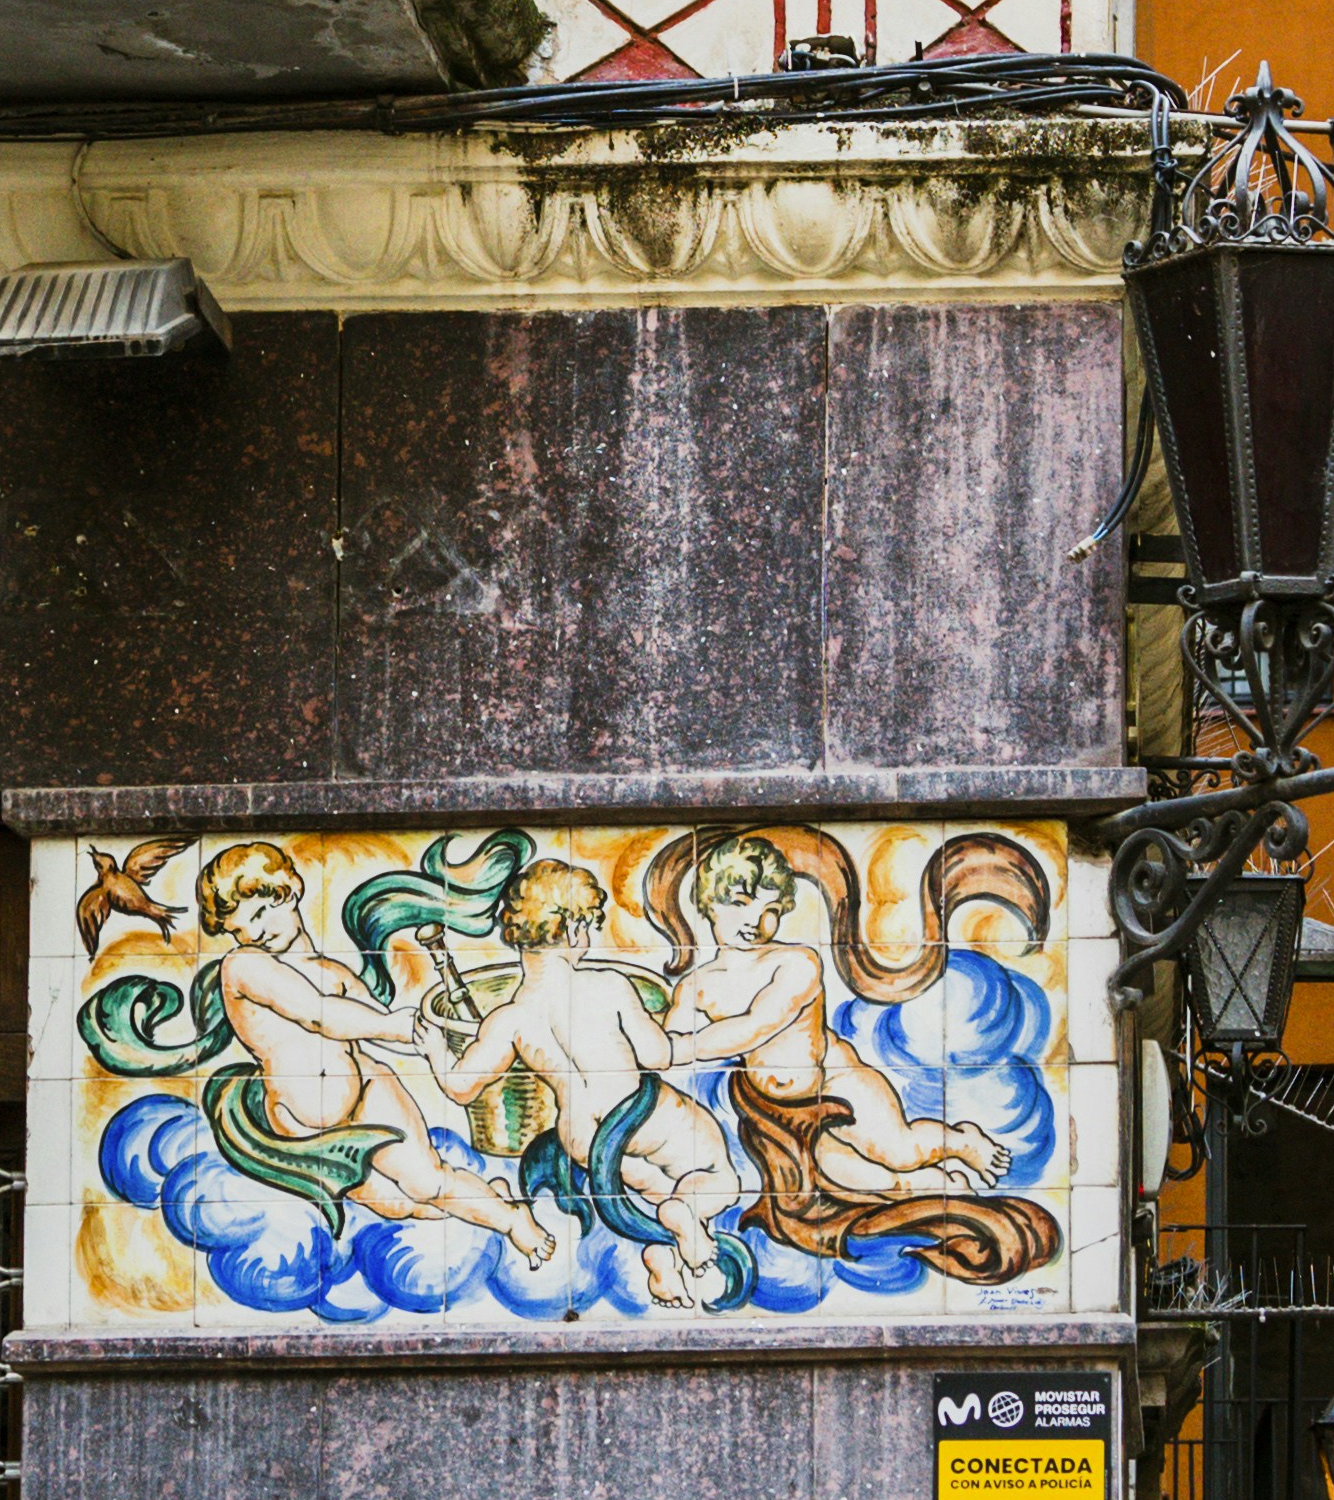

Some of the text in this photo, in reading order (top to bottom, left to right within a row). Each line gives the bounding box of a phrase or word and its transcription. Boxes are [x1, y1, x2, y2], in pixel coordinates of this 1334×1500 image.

[1034, 1391, 1100, 1402] MOVISTAR
[1034, 1404, 1105, 1415] PROSEGUR
[1034, 1417, 1091, 1427] ALARMAS
[950, 1458, 1092, 1474] CONECTADA
[950, 1476, 1092, 1489] CON AVISO A POLICÍA
